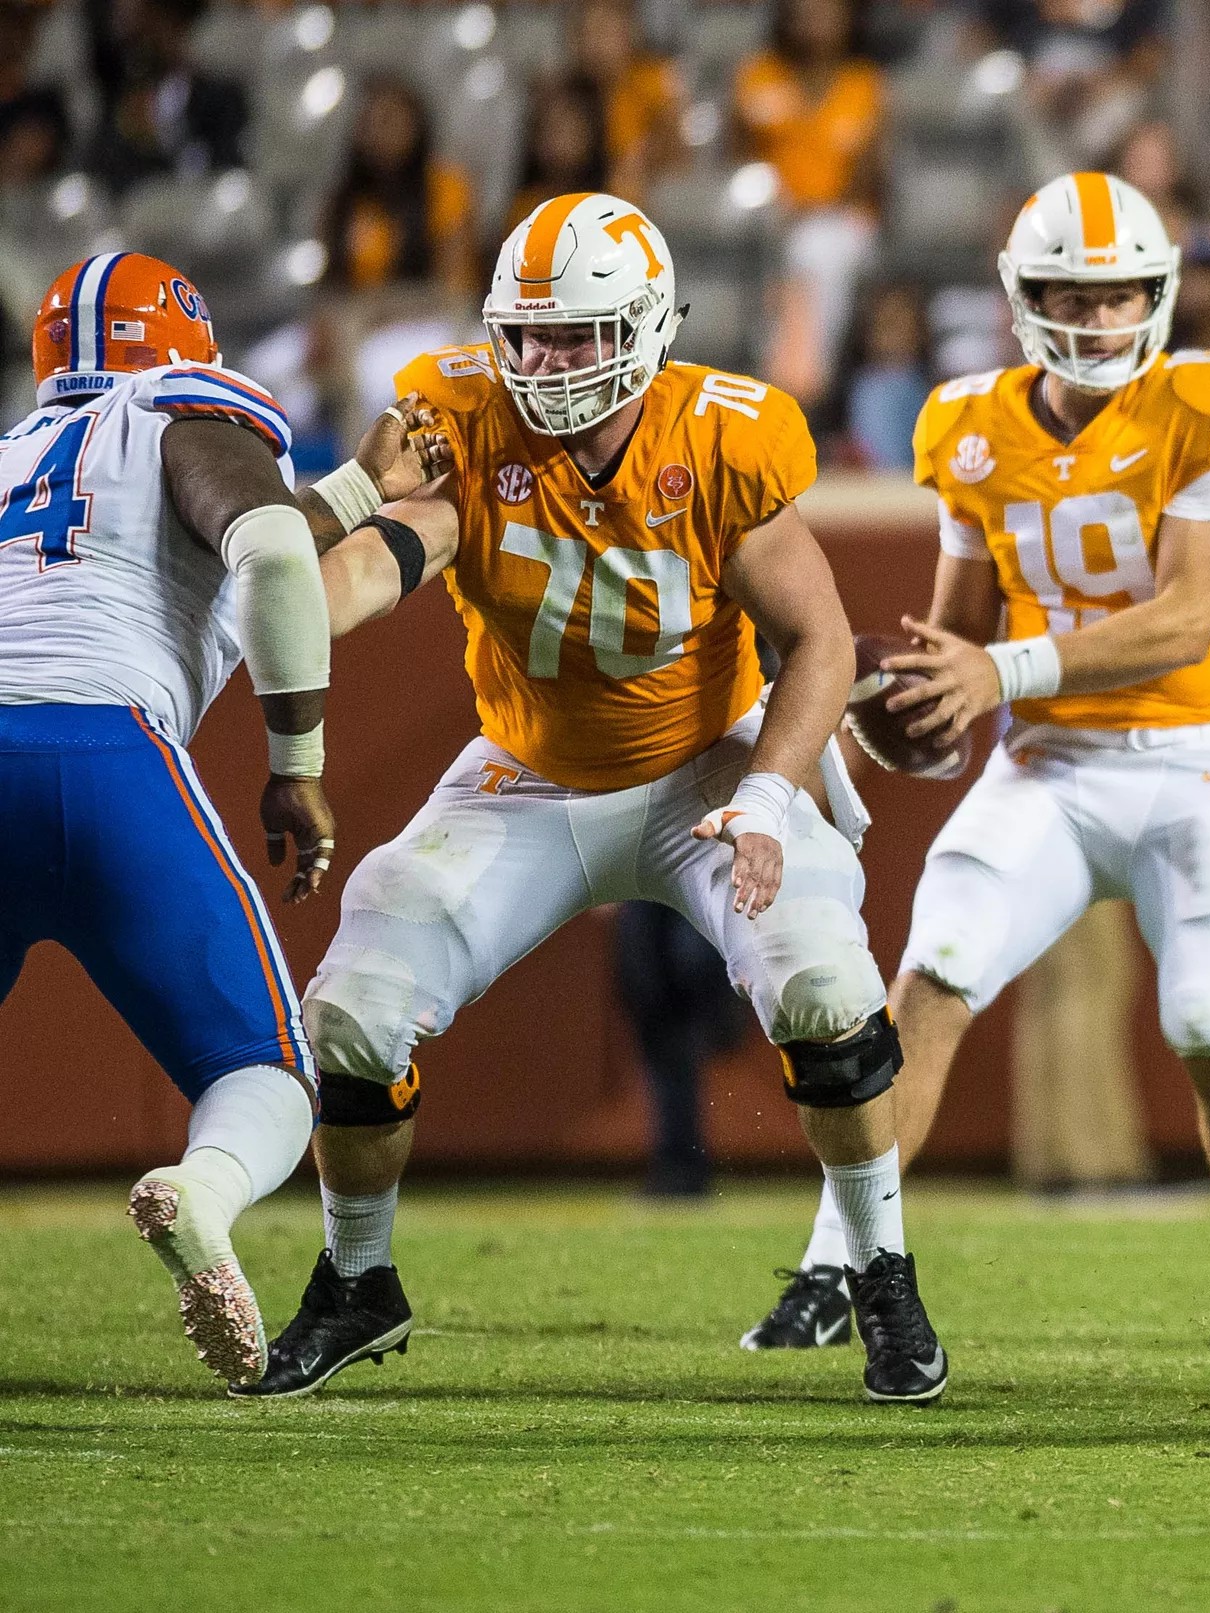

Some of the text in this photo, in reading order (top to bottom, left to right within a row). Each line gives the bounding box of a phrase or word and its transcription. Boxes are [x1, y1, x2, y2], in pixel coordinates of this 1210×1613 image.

[603, 213, 665, 280] T
[56, 376, 115, 393] FLORIDA
[693, 374, 769, 421] 70
[497, 464, 533, 503] SEC
[580, 500, 605, 526] T
[1003, 491, 1156, 636] 19
[499, 521, 693, 680] 70
[475, 759, 523, 796] T
